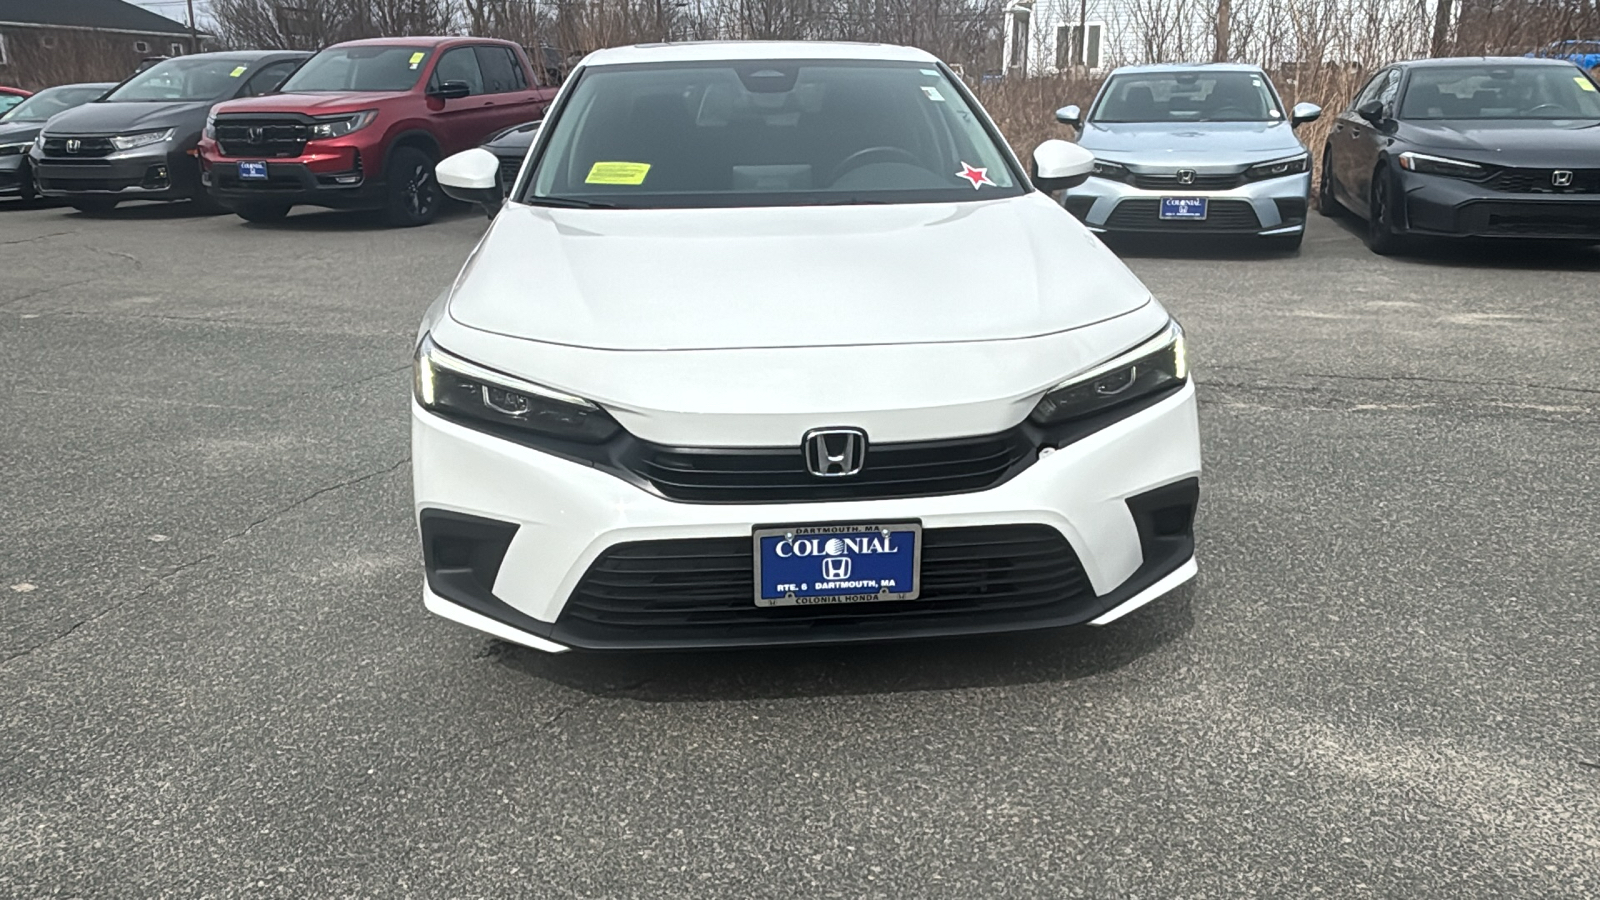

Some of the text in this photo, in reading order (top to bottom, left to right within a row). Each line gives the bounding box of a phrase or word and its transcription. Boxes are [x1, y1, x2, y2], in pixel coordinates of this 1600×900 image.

[775, 537, 898, 558] COLONIAL
[777, 579, 896, 592] RTE. 6 DARTMOUTH, MA
[796, 594, 879, 604] COLONIAL HONDA
